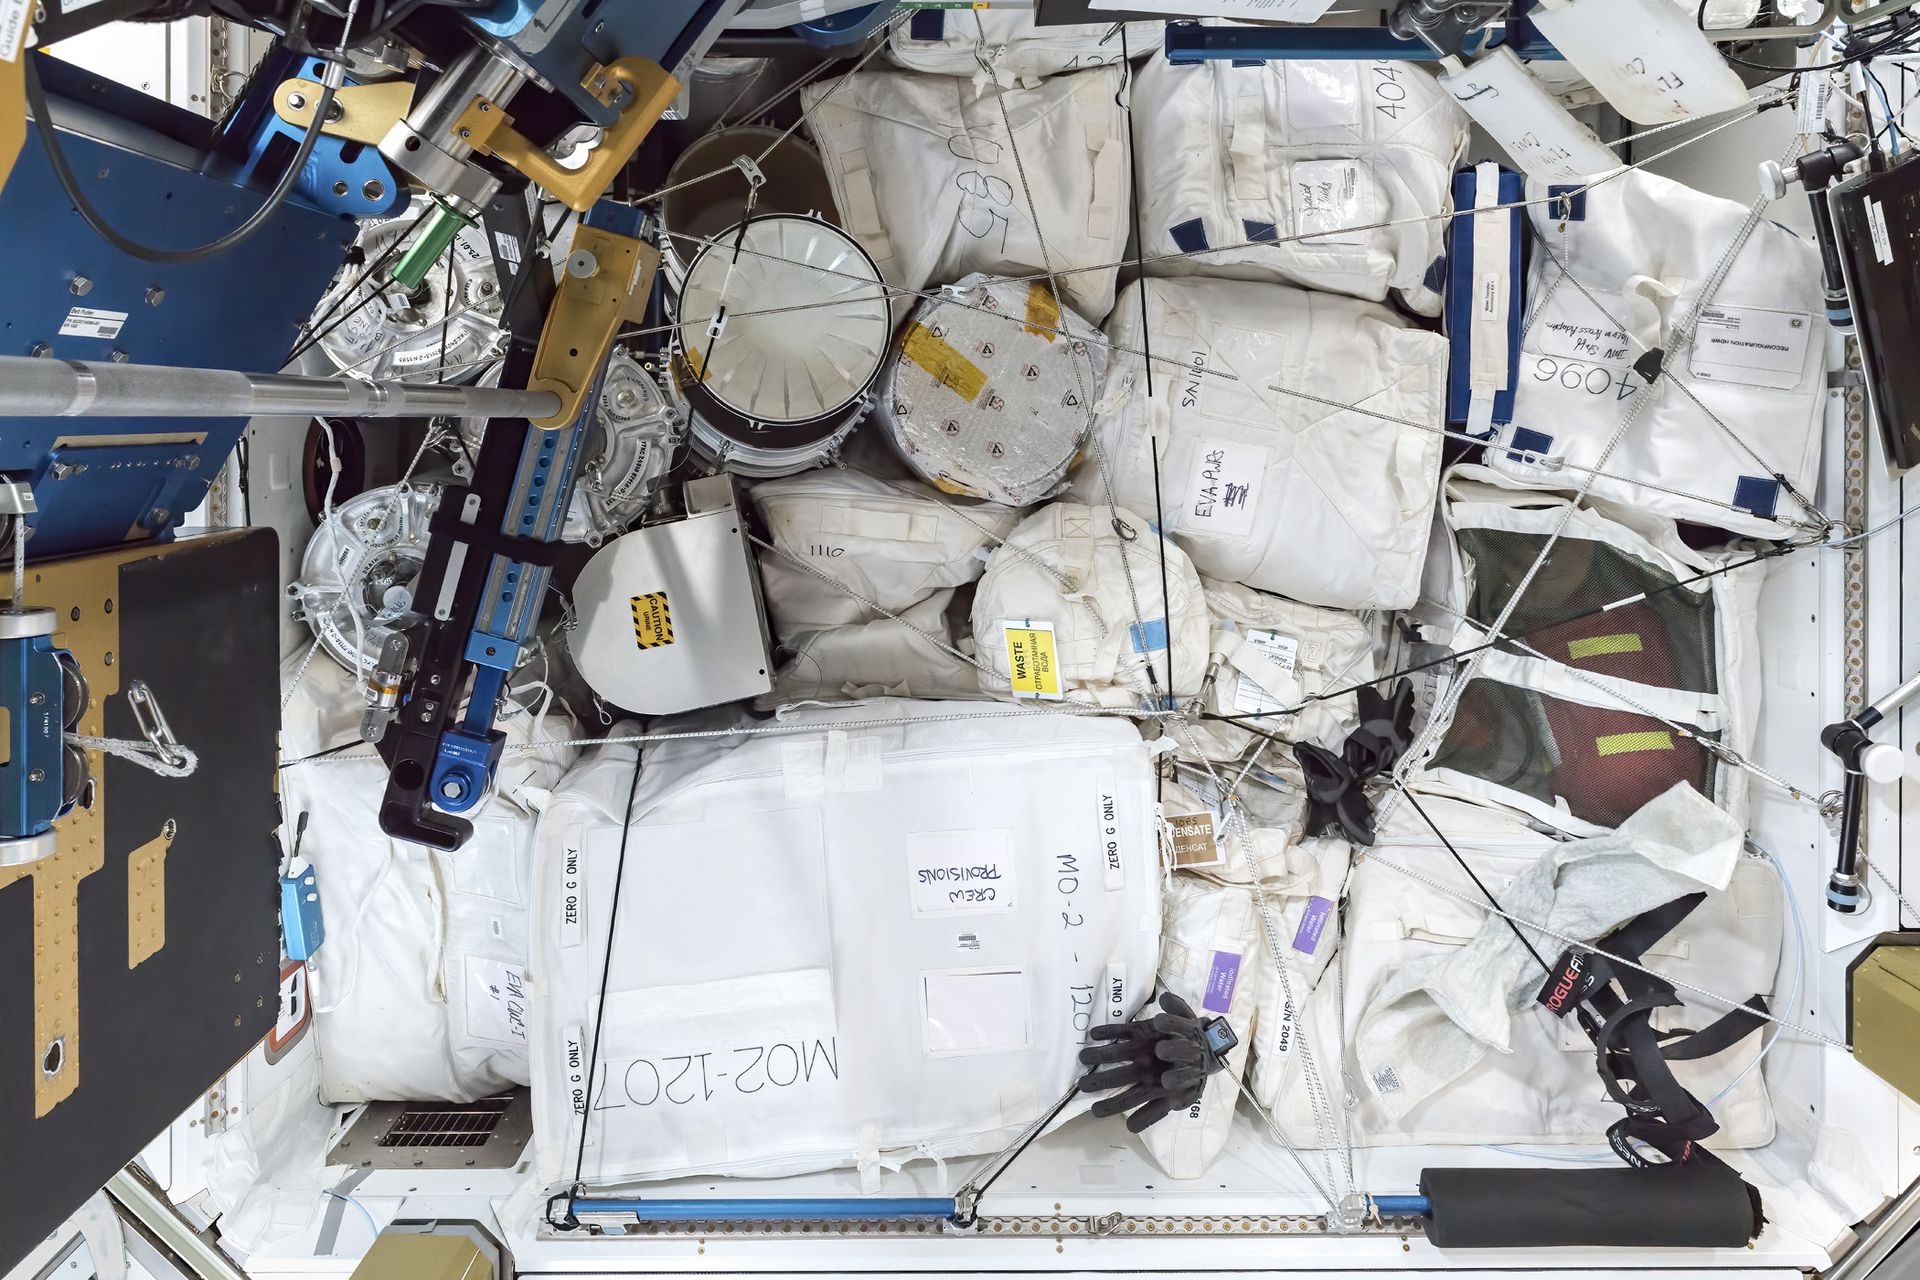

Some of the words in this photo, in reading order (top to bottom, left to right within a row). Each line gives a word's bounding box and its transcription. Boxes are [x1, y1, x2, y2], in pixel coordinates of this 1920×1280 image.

[1373, 57, 1407, 119] 404
[1730, 340, 1790, 352] RECONFIGURATION
[1533, 357, 1638, 401] 4096
[811, 544, 845, 558] 1110
[649, 598, 664, 641] CAUTION
[1013, 641, 1027, 680] WASTE
[1029, 632, 1043, 690] ОТРАБОТАННАЯ
[1040, 652, 1049, 673] ВОДА
[1102, 794, 1115, 821] ONLY
[1105, 827, 1116, 835] G
[566, 848, 579, 875] ONLY
[1106, 841, 1120, 870] ZERO
[566, 881, 578, 889] G
[918, 863, 1002, 886] PROVISIONS
[949, 887, 996, 903] CREW
[565, 894, 578, 925] ZERO
[1305, 914, 1319, 934] Water
[1112, 977, 1124, 1003] ONLY
[1217, 971, 1228, 992] Water
[1222, 966, 1237, 1000] Iodinated
[1112, 1009, 1123, 1017] G
[1278, 1022, 1291, 1052] 2049
[568, 1039, 581, 1068] ONLY
[570, 1074, 582, 1082] G
[593, 1036, 839, 1111] MO2-1207
[574, 1086, 586, 1116] ZERO
